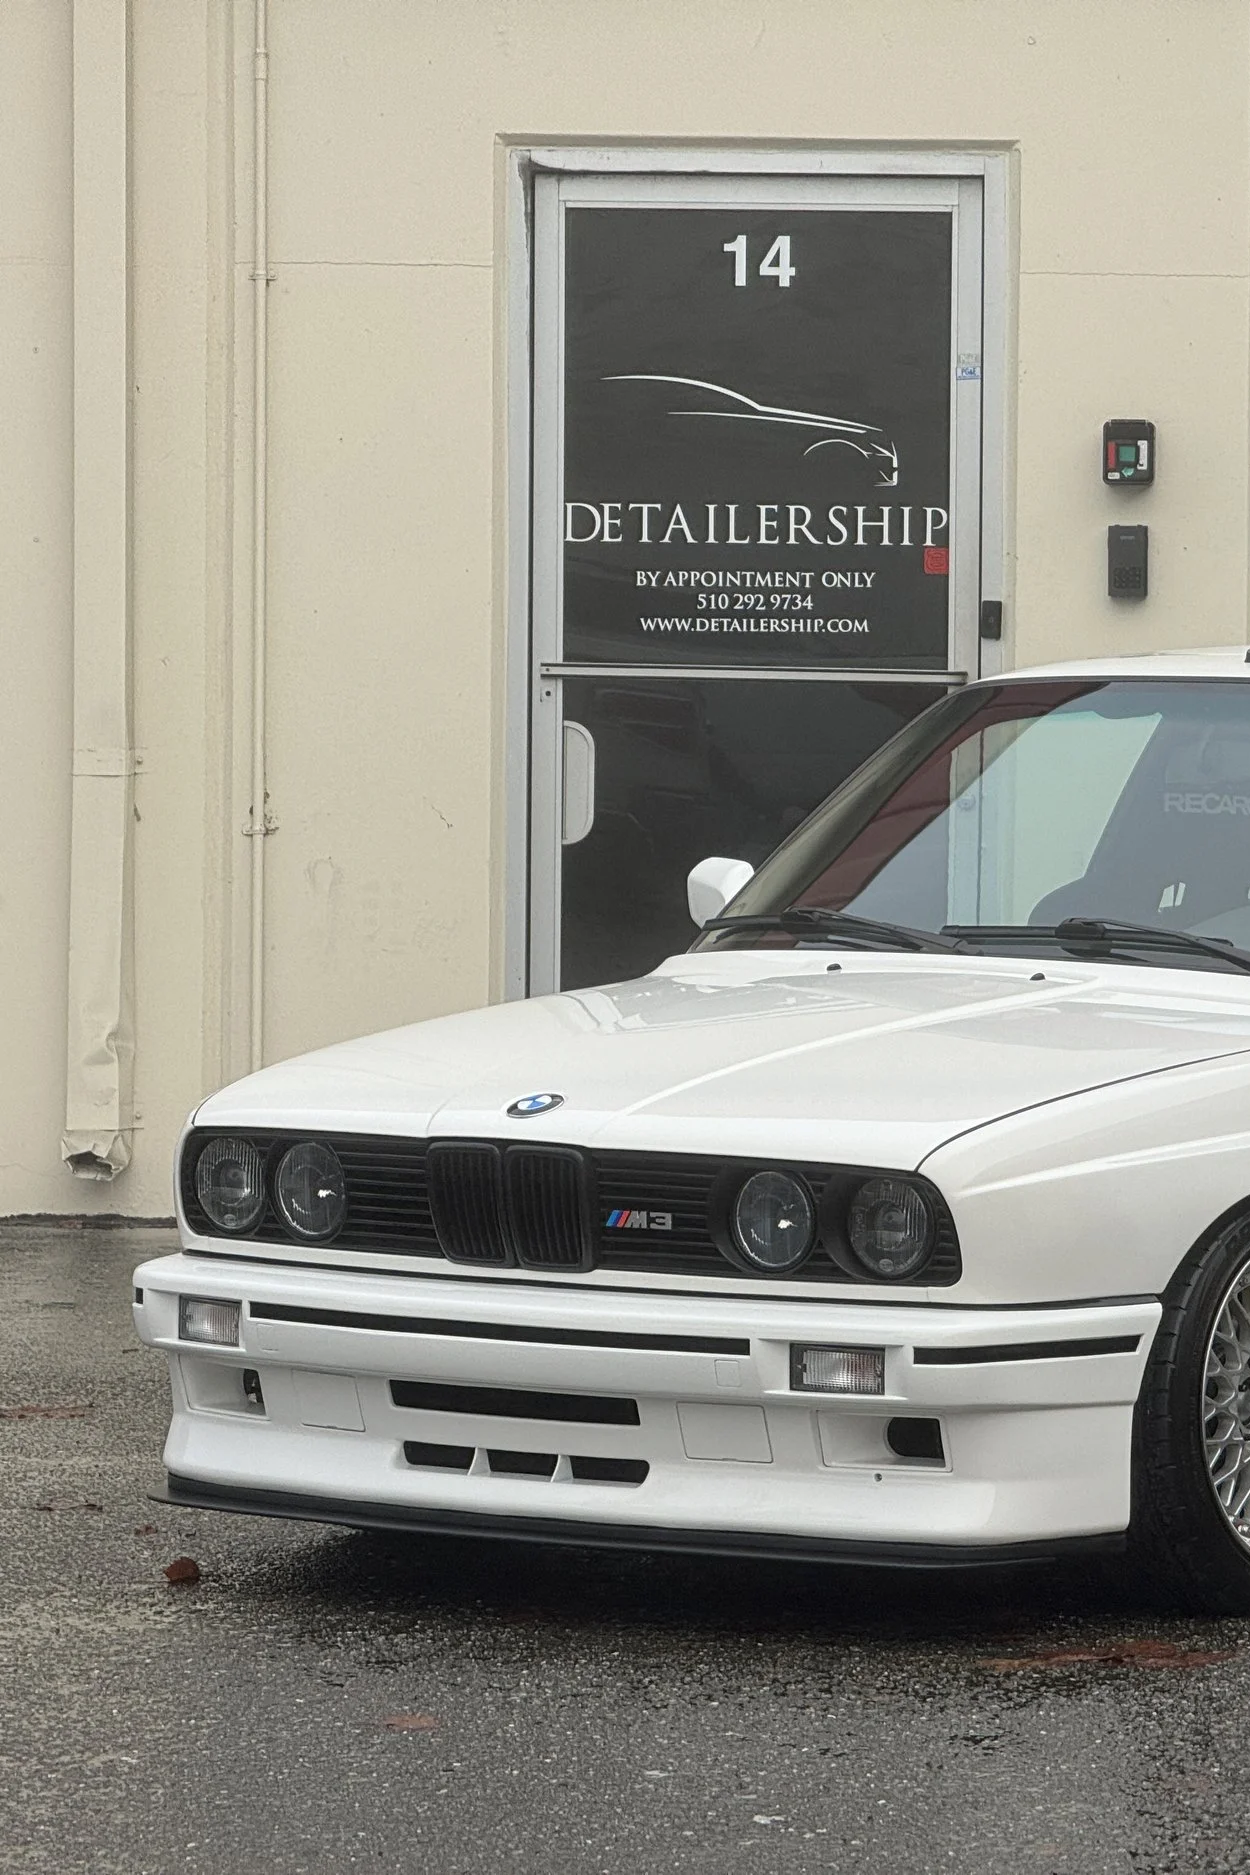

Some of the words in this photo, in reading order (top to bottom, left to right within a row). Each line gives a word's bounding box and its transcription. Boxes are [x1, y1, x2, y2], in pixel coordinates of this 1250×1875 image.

[724, 235, 796, 287] 14
[564, 503, 948, 546] DETAILERSHIP
[636, 571, 661, 587] BY
[664, 571, 815, 588] APPOINTMENT
[822, 572, 876, 588] ONLY
[696, 594, 730, 610] 510
[734, 594, 766, 610] 292
[770, 594, 814, 611] 9734
[640, 617, 870, 633] WWW.DETAILERSHIP.COM
[624, 1210, 673, 1230] M3
